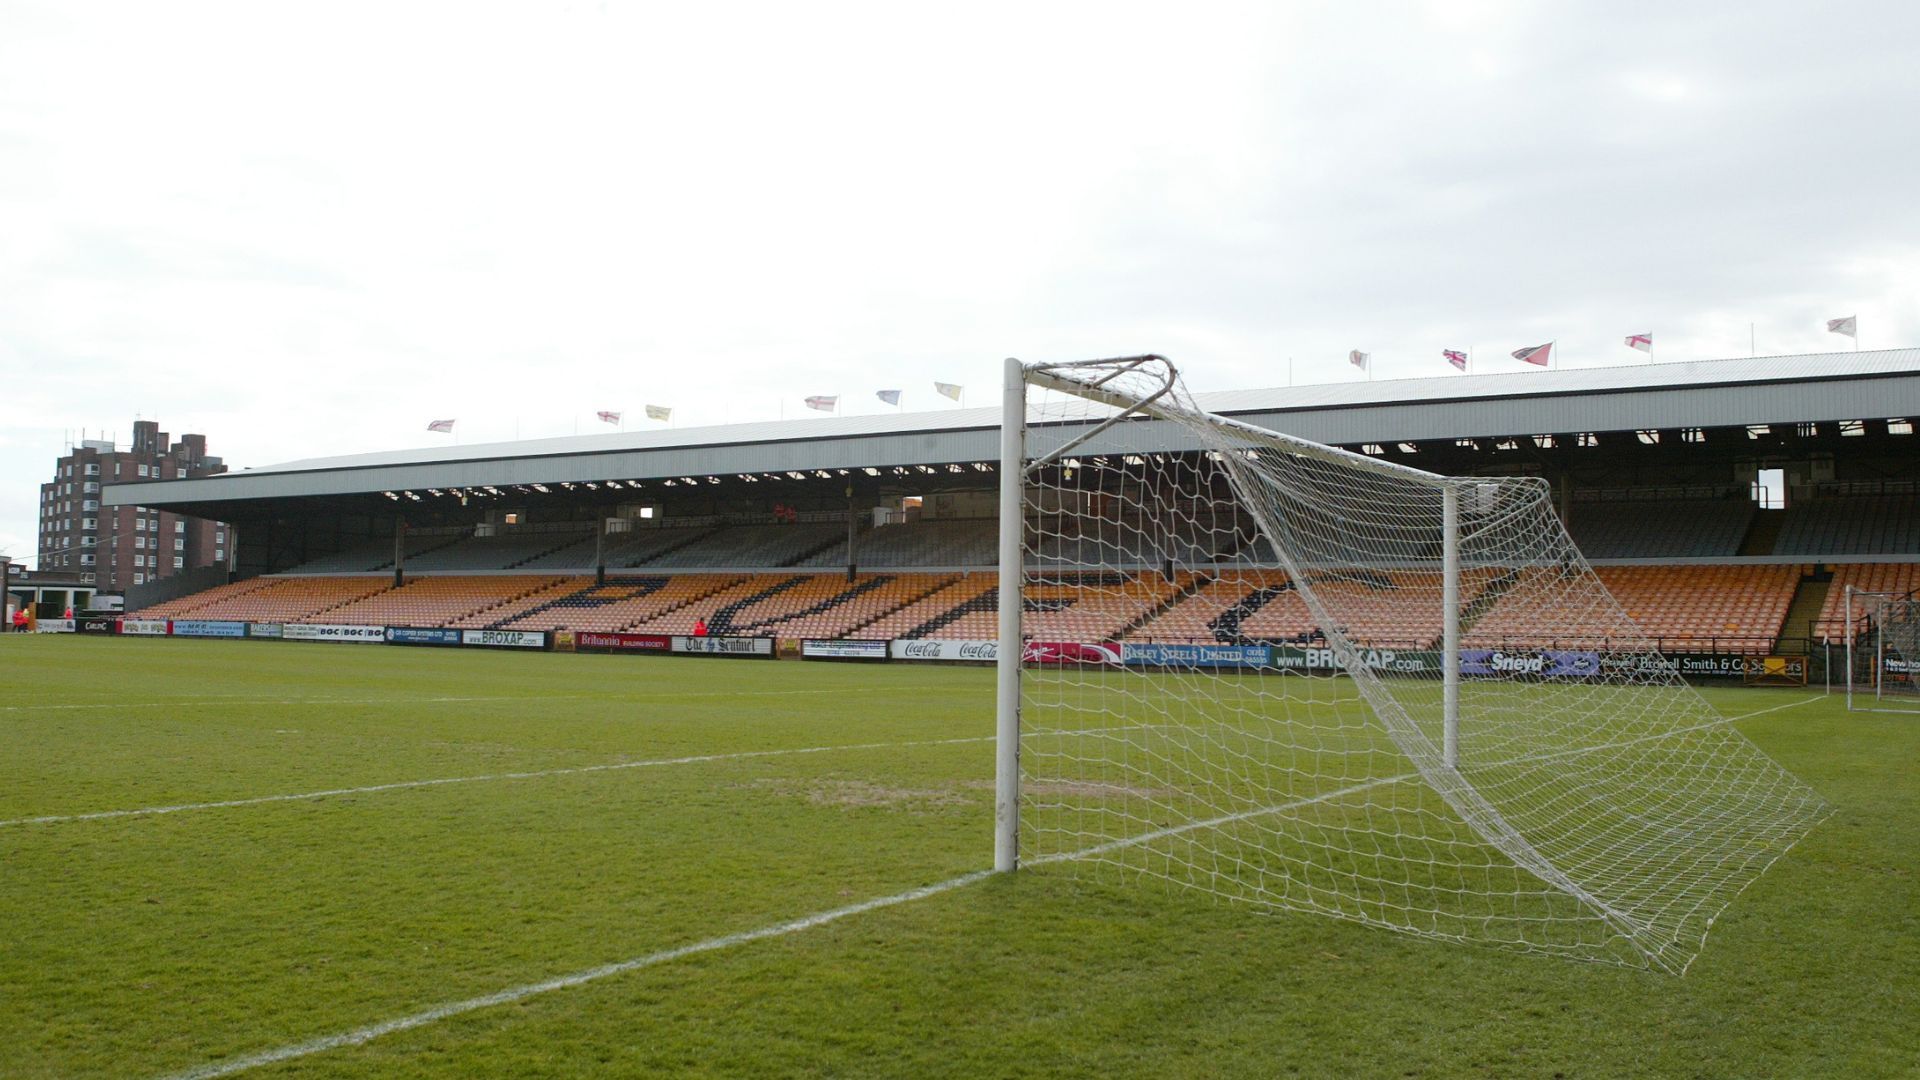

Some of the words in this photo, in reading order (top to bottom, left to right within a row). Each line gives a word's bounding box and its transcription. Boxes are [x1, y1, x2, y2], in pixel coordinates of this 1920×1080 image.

[581, 634, 620, 646] Britannia
[686, 636, 703, 651] The
[719, 638, 755, 652] Sentinel
[1491, 653, 1544, 673] Sneyd
[1683, 658, 1718, 670] Smith
[1721, 659, 1731, 670] &
[1732, 659, 1749, 671] Co
[1751, 659, 1802, 671] Soors
